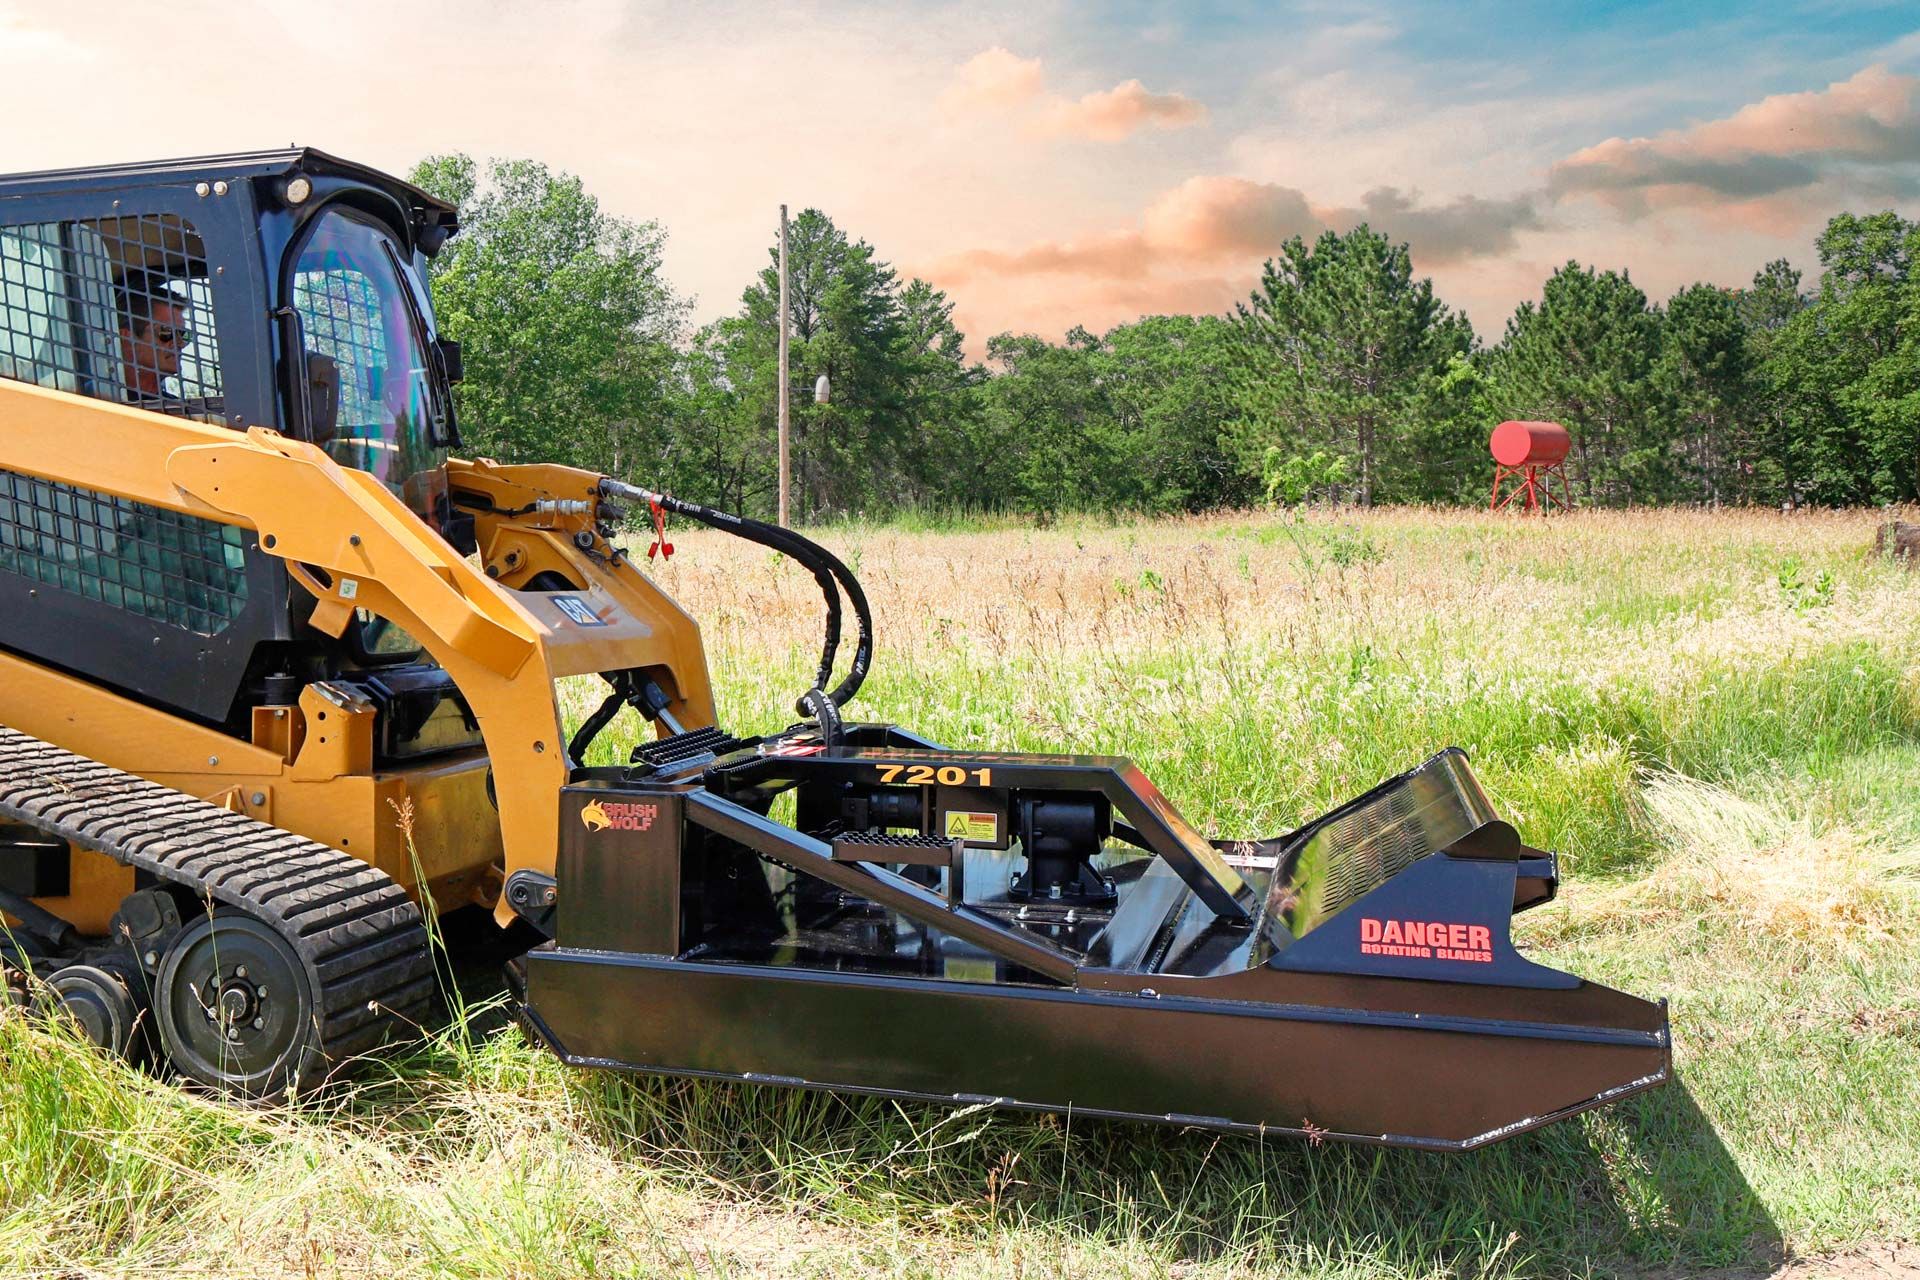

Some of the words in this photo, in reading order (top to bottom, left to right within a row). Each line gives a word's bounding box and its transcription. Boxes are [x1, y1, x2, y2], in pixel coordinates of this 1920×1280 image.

[554, 598, 601, 624] CAT
[875, 764, 992, 787] 7201
[602, 802, 657, 819] BRUSH
[608, 816, 652, 831] WOLF
[1361, 918, 1491, 950] DANGER
[1361, 943, 1431, 958] ROTATING
[1437, 948, 1492, 963] BLADES
